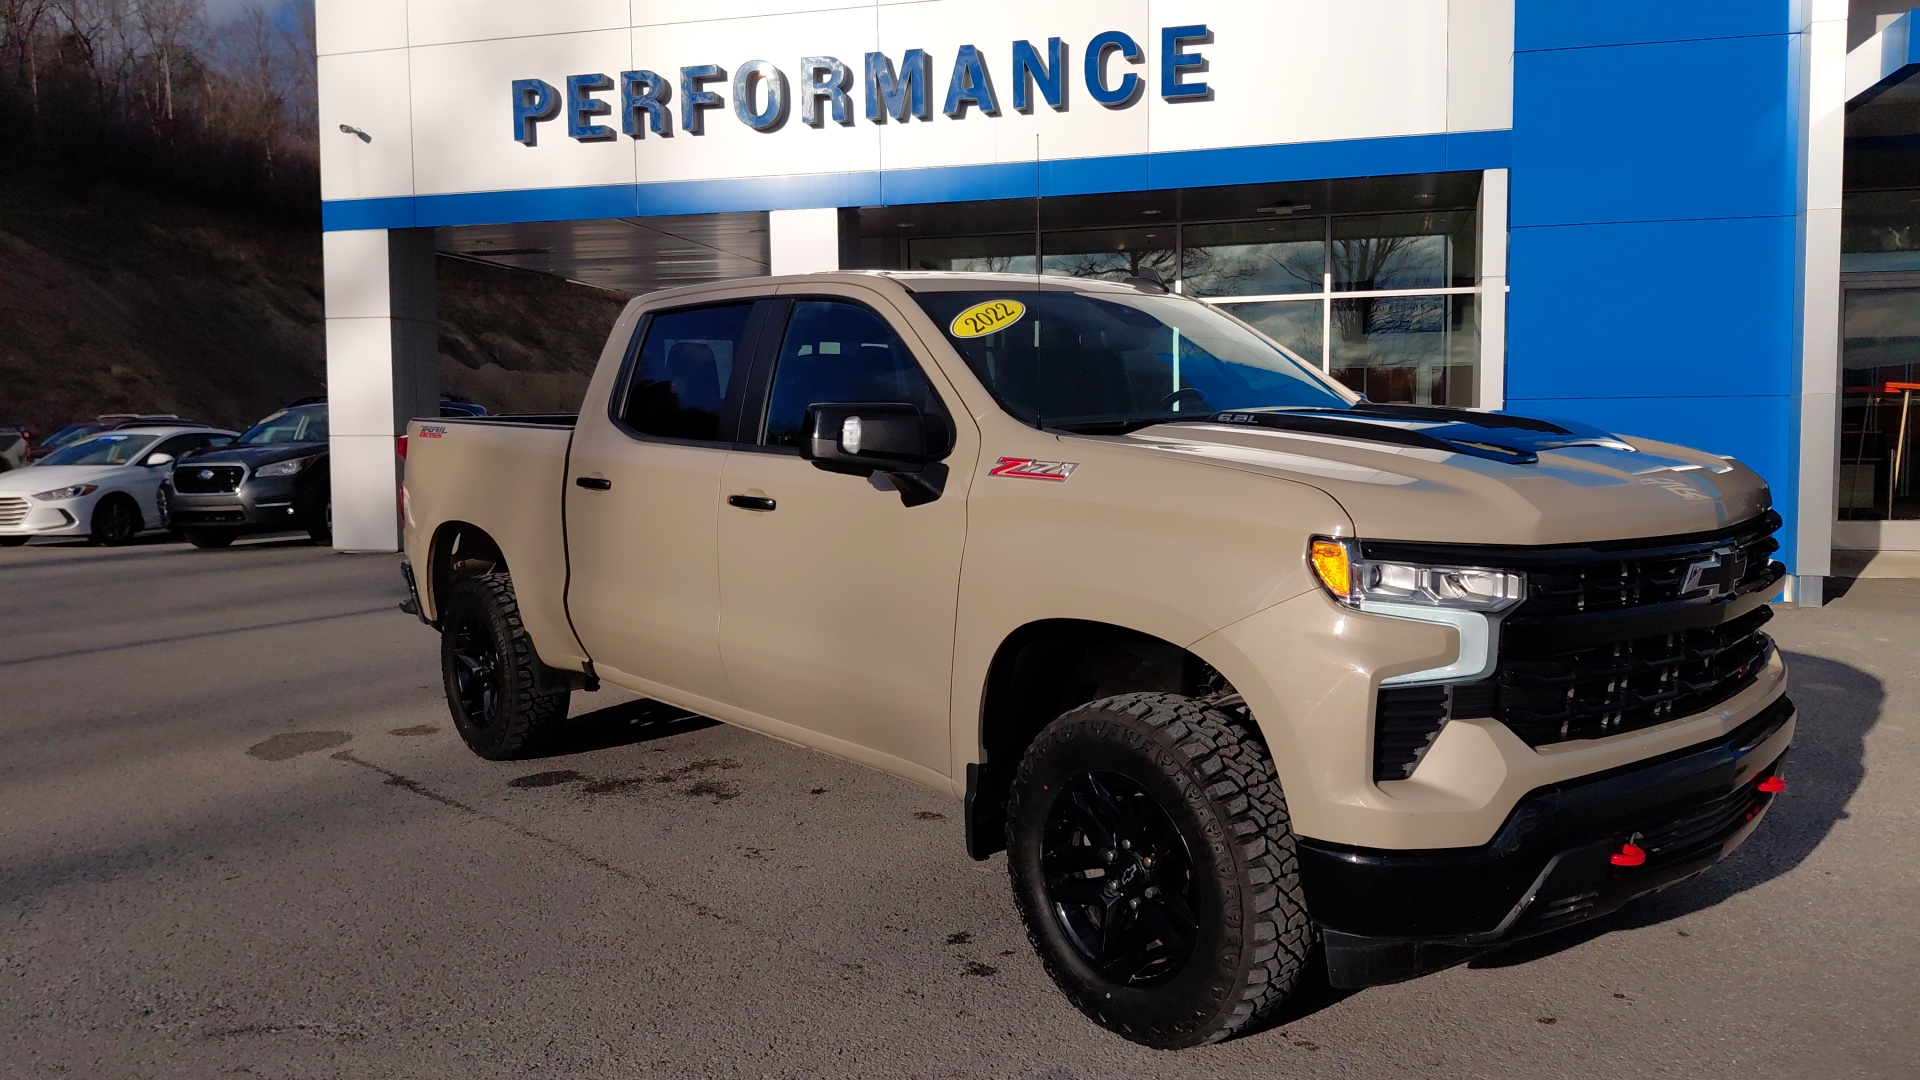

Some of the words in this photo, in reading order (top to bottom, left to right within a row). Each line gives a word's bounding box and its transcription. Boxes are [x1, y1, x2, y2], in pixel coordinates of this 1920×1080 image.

[511, 25, 1213, 145] PERFORMANCE
[964, 302, 1015, 333] 2022
[420, 425, 448, 433] TRAIL
[987, 456, 1080, 483] Z71
